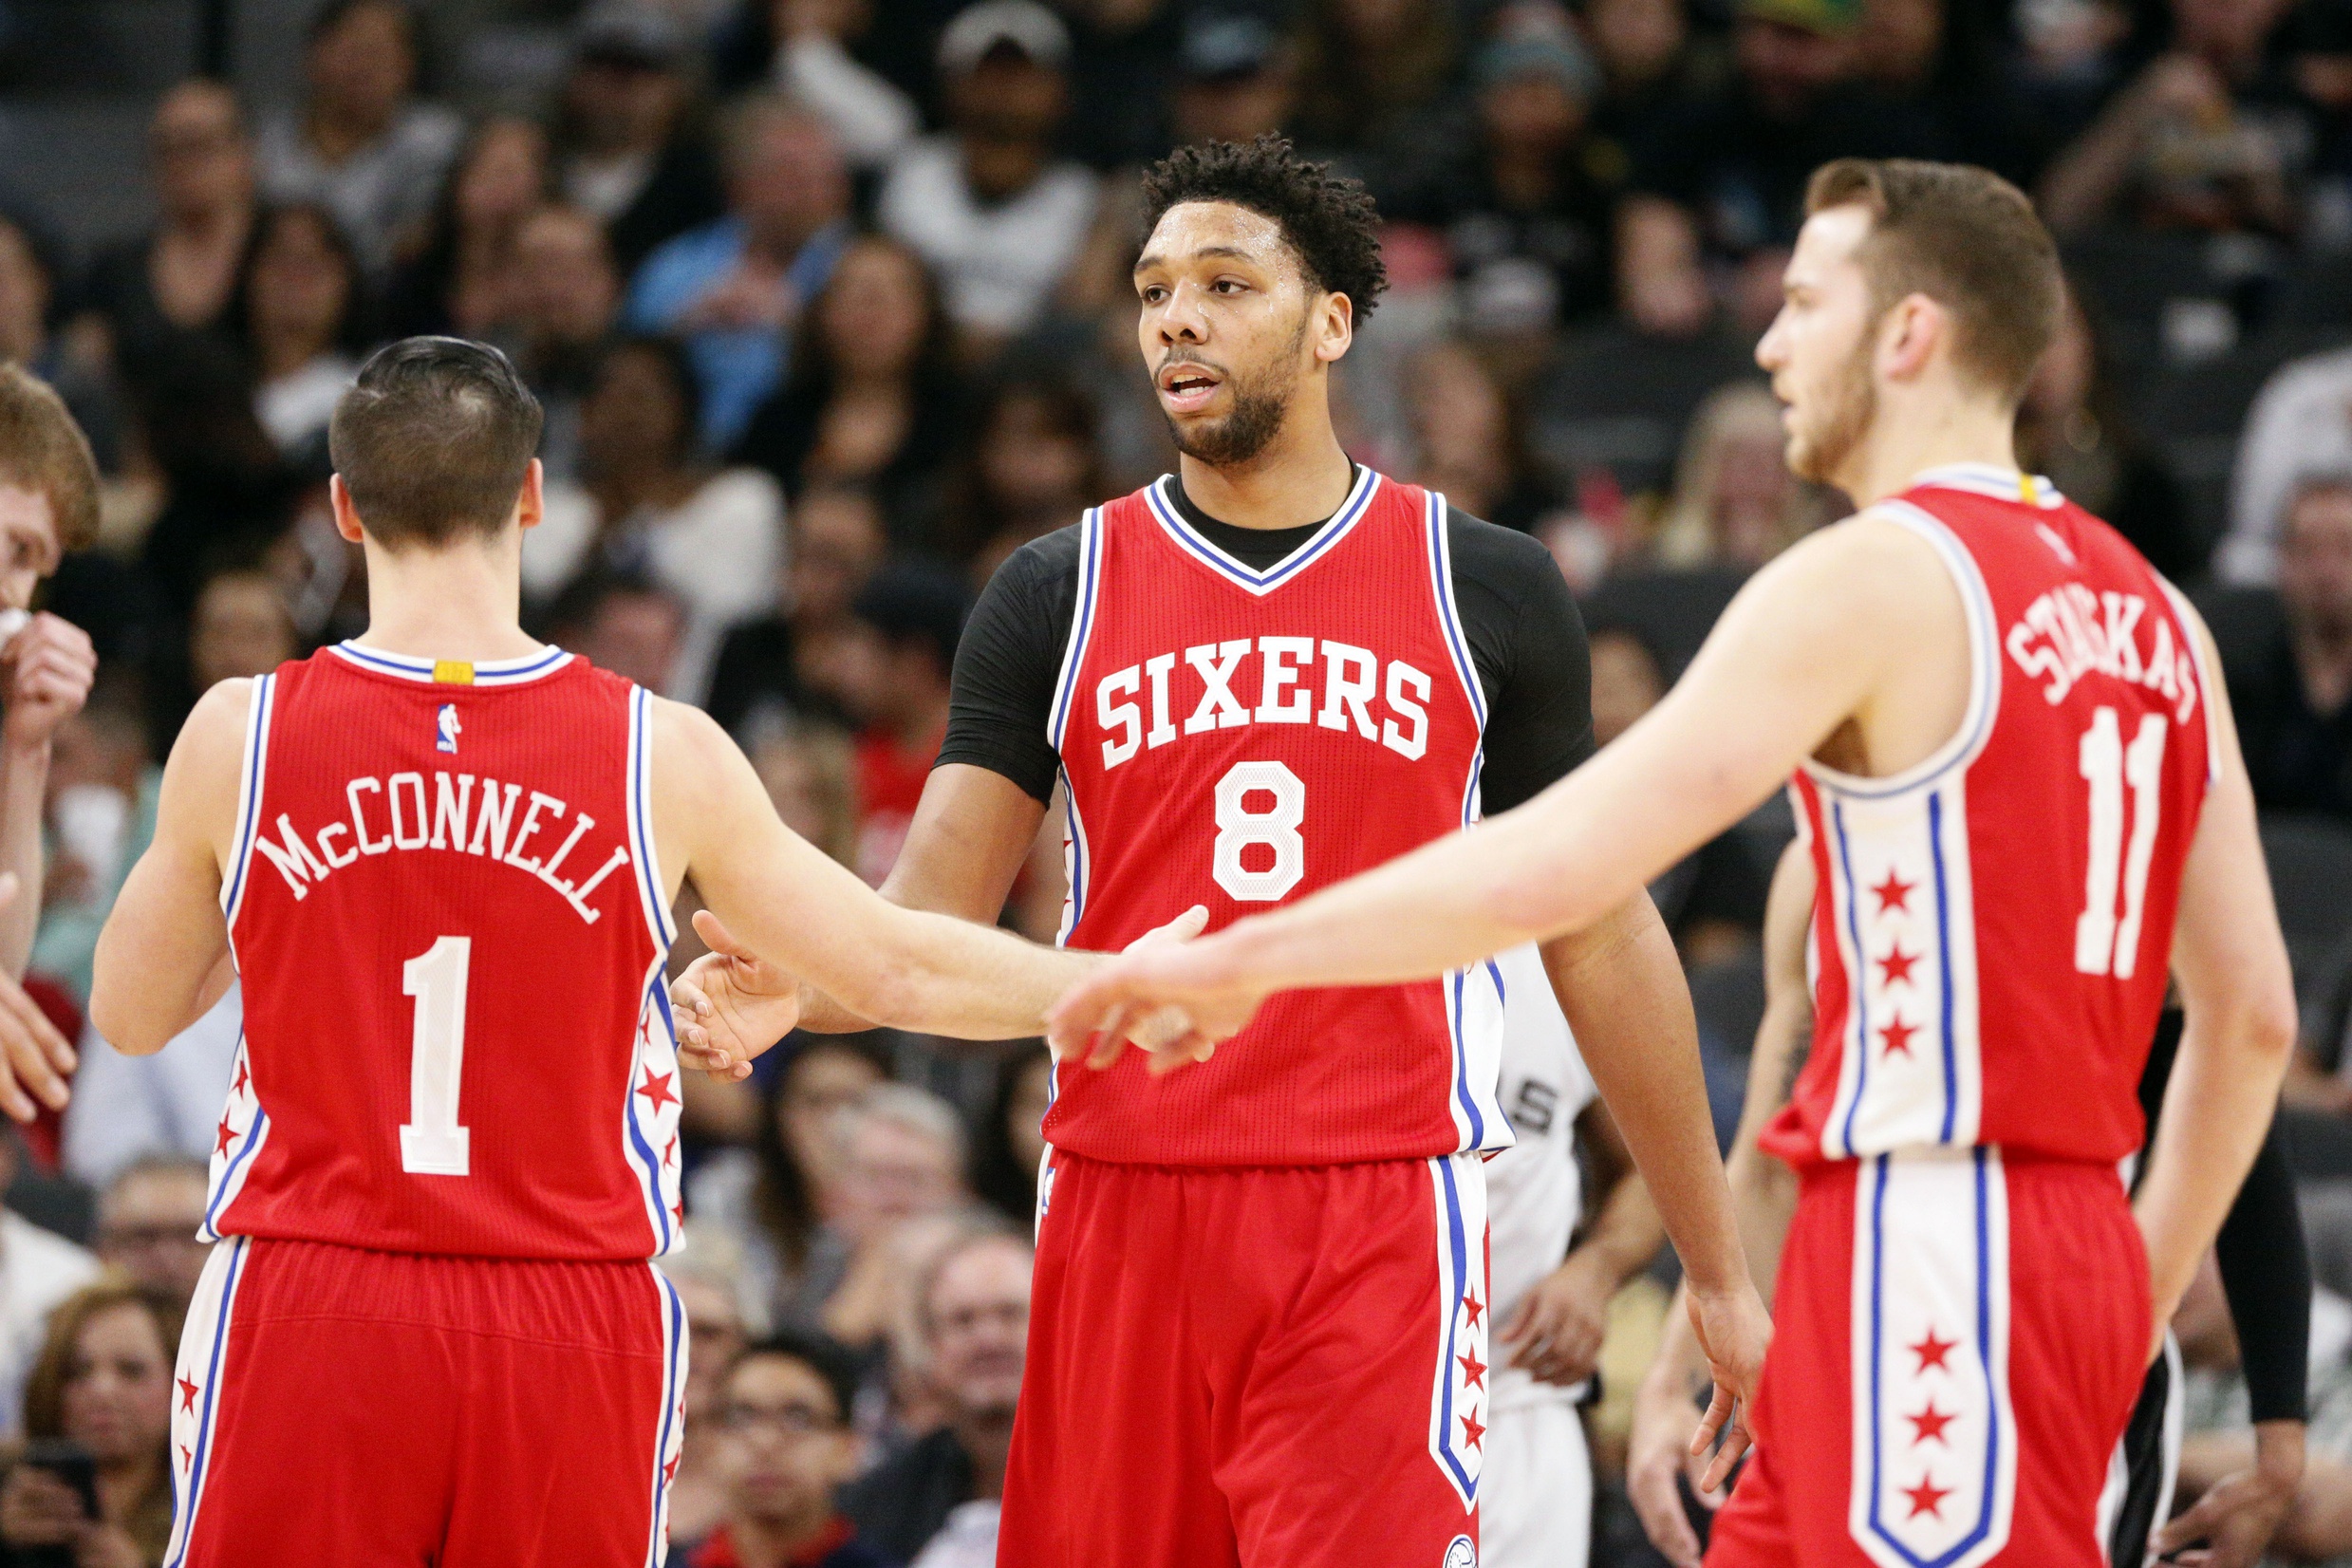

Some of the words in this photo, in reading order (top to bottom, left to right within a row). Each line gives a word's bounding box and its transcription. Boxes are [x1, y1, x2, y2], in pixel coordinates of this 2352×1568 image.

[1096, 636, 1431, 771] SIXERS
[2006, 583, 2196, 725] STKAS
[255, 772, 630, 924] McCONNELL
[1212, 760, 1305, 901] 8
[2075, 705, 2168, 980] 11
[400, 936, 471, 1176] 1
